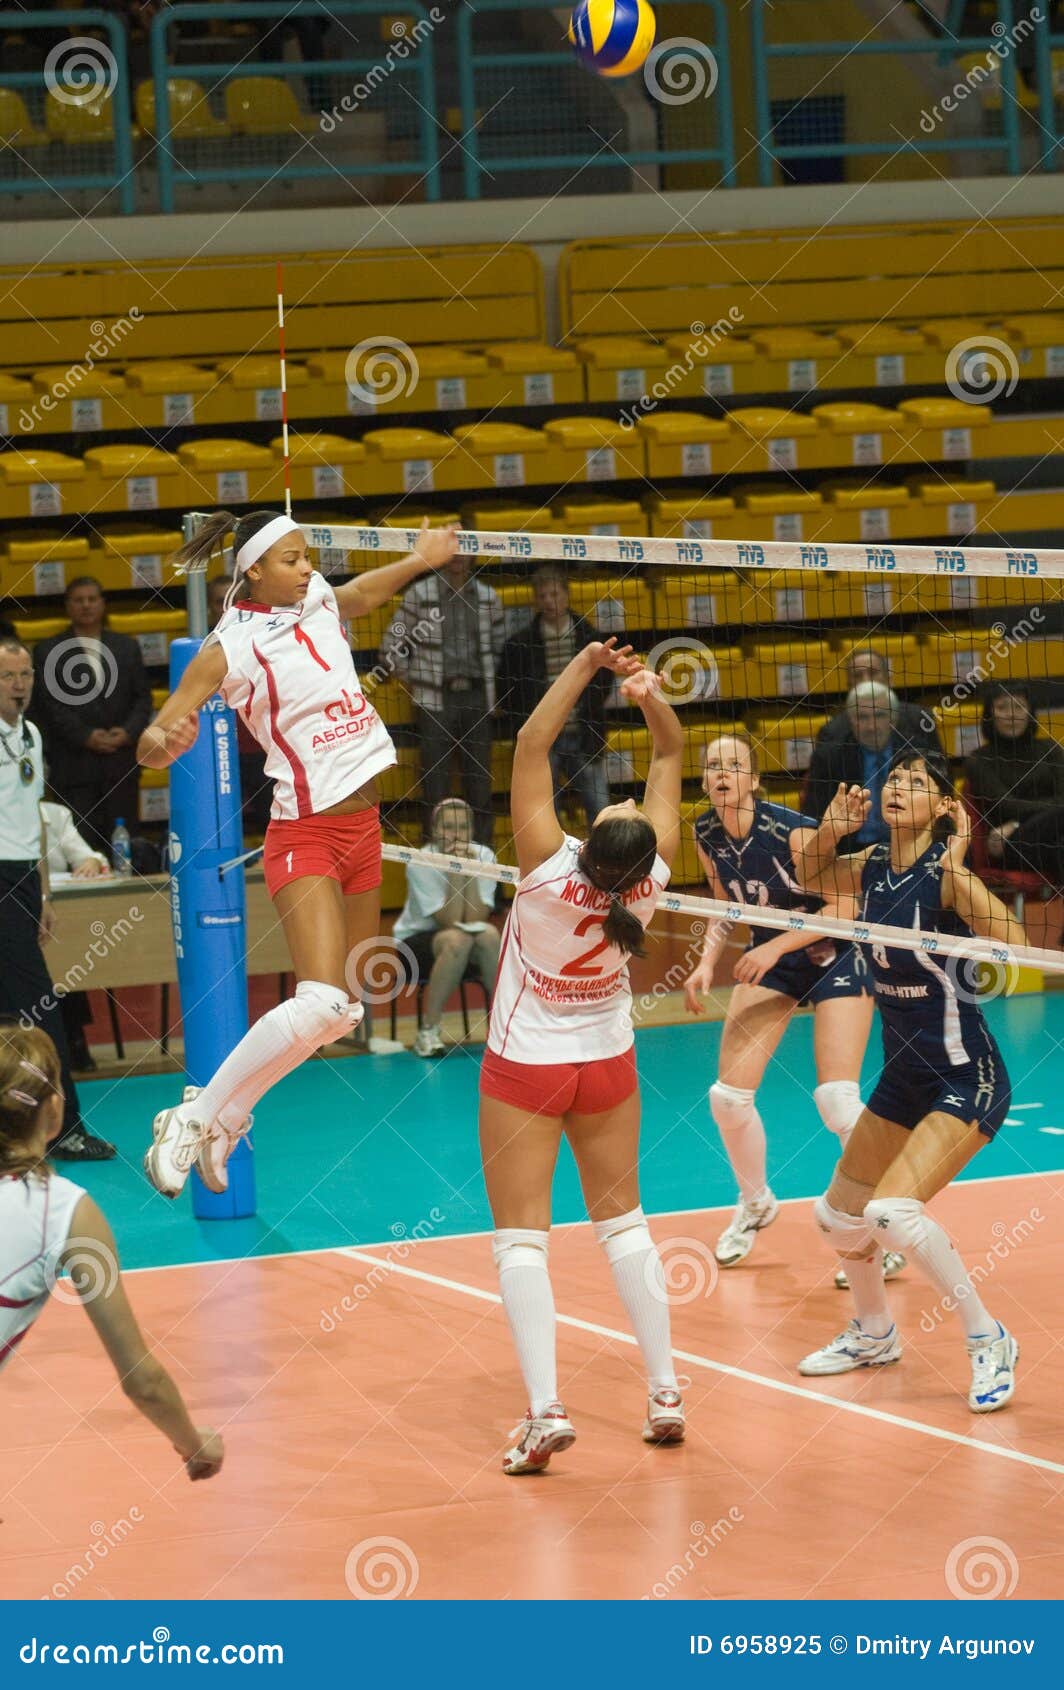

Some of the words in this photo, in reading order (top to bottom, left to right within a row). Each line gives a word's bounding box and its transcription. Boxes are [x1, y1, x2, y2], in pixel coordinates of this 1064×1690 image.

[618, 540, 644, 560] FIVB
[675, 542, 703, 562] FIVB
[736, 544, 764, 565] FIVB
[799, 546, 828, 567] FIVB
[865, 548, 896, 570] FIVB
[934, 550, 966, 572] FIVB
[1006, 552, 1038, 575] FIVB
[293, 622, 331, 672] 1
[218, 736, 231, 795] Senoh
[286, 851, 293, 873] 1
[171, 875, 185, 959] Senoh
[559, 914, 611, 976] 2
